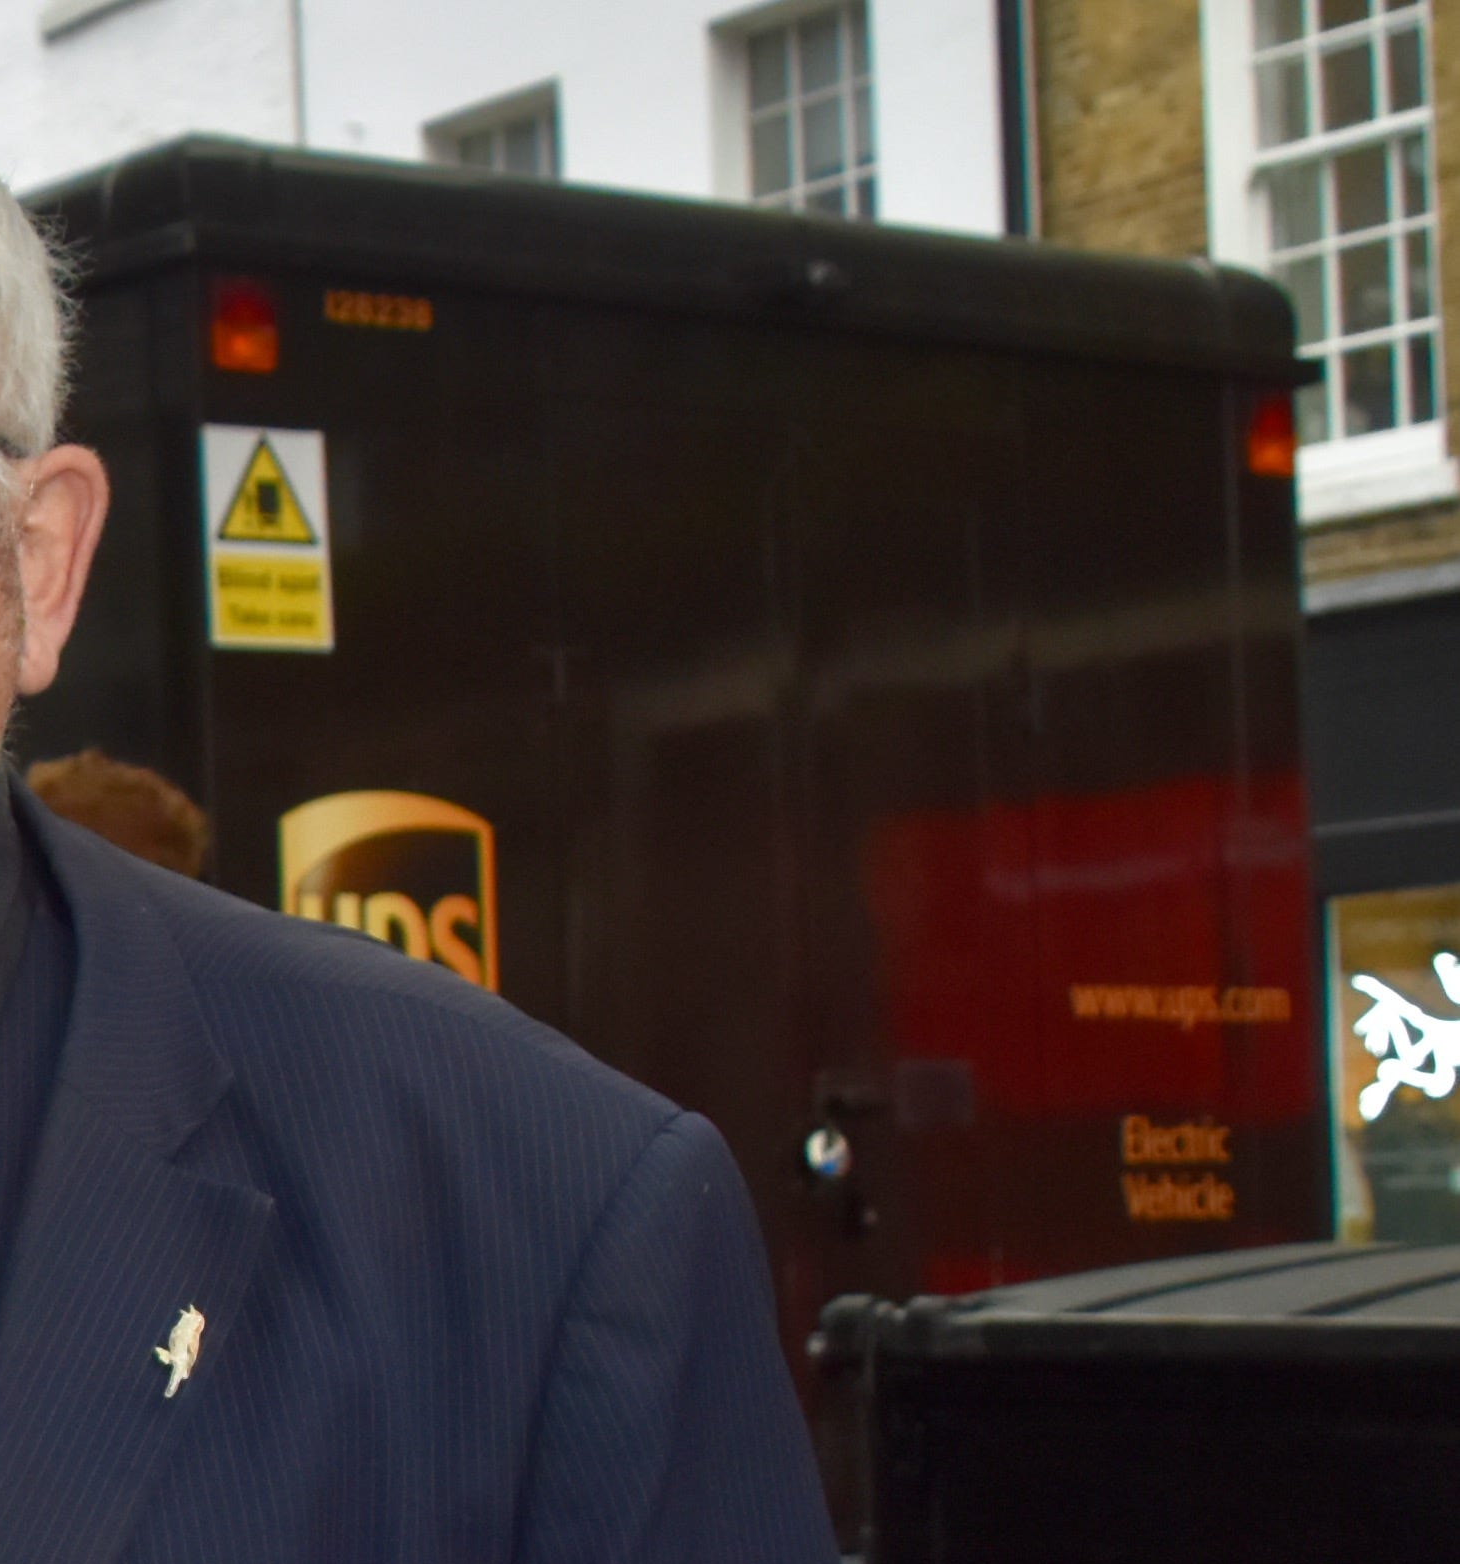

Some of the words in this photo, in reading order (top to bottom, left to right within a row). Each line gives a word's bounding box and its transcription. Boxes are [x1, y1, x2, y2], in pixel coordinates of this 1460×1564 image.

[1071, 985, 1290, 1031] www.ups.com
[1123, 1114, 1231, 1163] Electric
[1123, 1173, 1234, 1221] Vehicle
